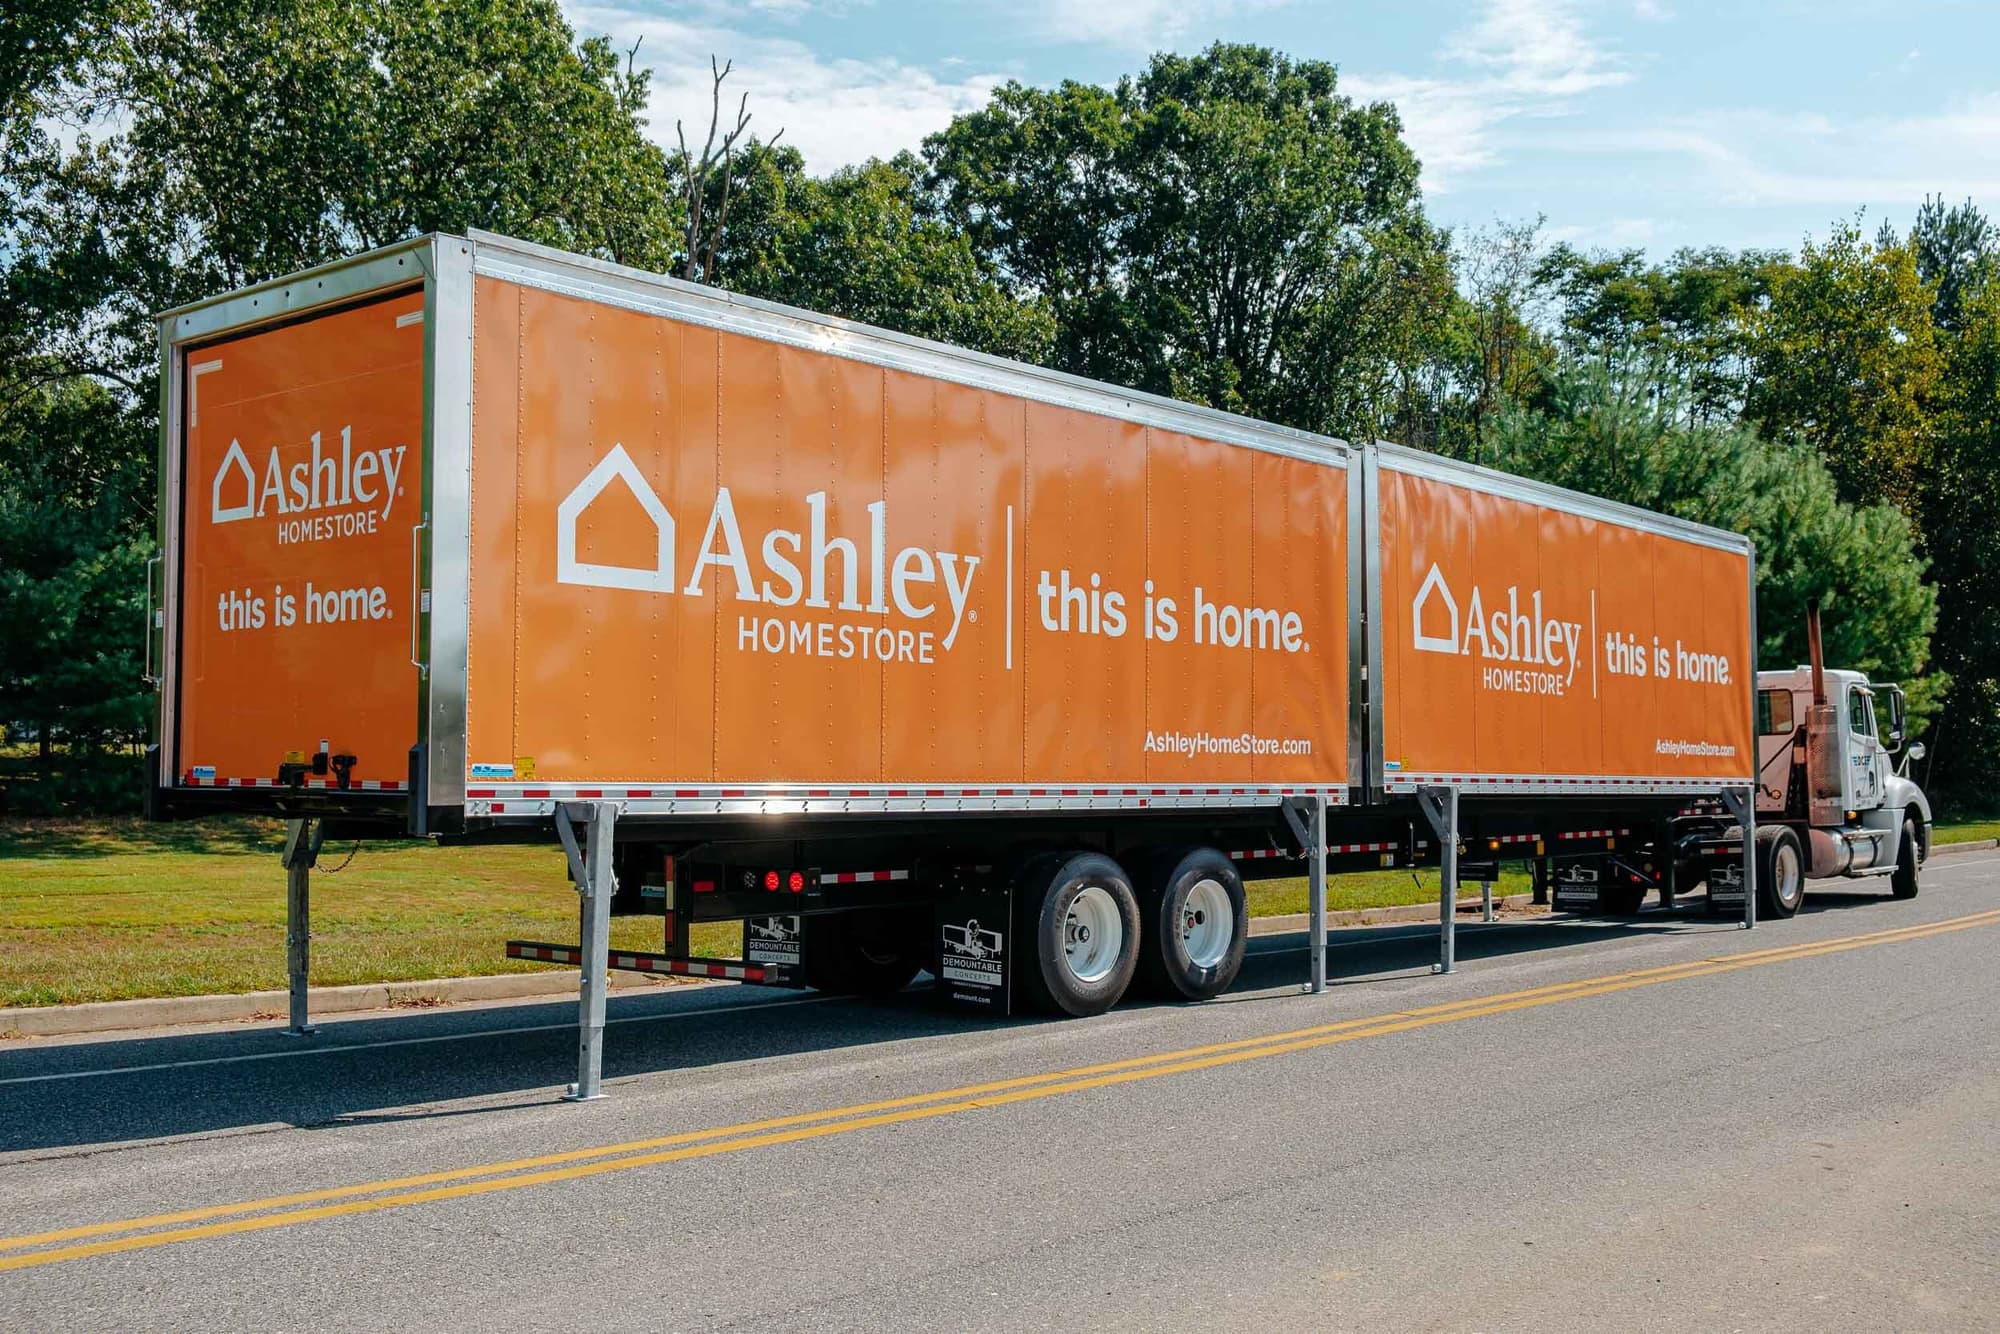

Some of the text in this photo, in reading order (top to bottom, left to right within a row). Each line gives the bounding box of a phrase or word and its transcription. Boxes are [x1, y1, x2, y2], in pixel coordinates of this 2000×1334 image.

[278, 510, 377, 545] HOMESTORE
[218, 586, 266, 631] this
[274, 585, 297, 627] is
[1037, 569, 1128, 638] this
[1144, 579, 1179, 642] is
[738, 615, 934, 664] HOMESTORE
[1605, 631, 1648, 678] this
[1653, 636, 1671, 679] is
[1483, 668, 1564, 696] HOMESTORE
[1143, 731, 1312, 758] AshleyHomeStore.com
[1655, 739, 1736, 758] AshleyHomeStore.com
[749, 942, 801, 953] DEMOUNTABLE
[943, 957, 1002, 973] DEMOUNTABLE
[954, 970, 991, 982] CONCEPTS
